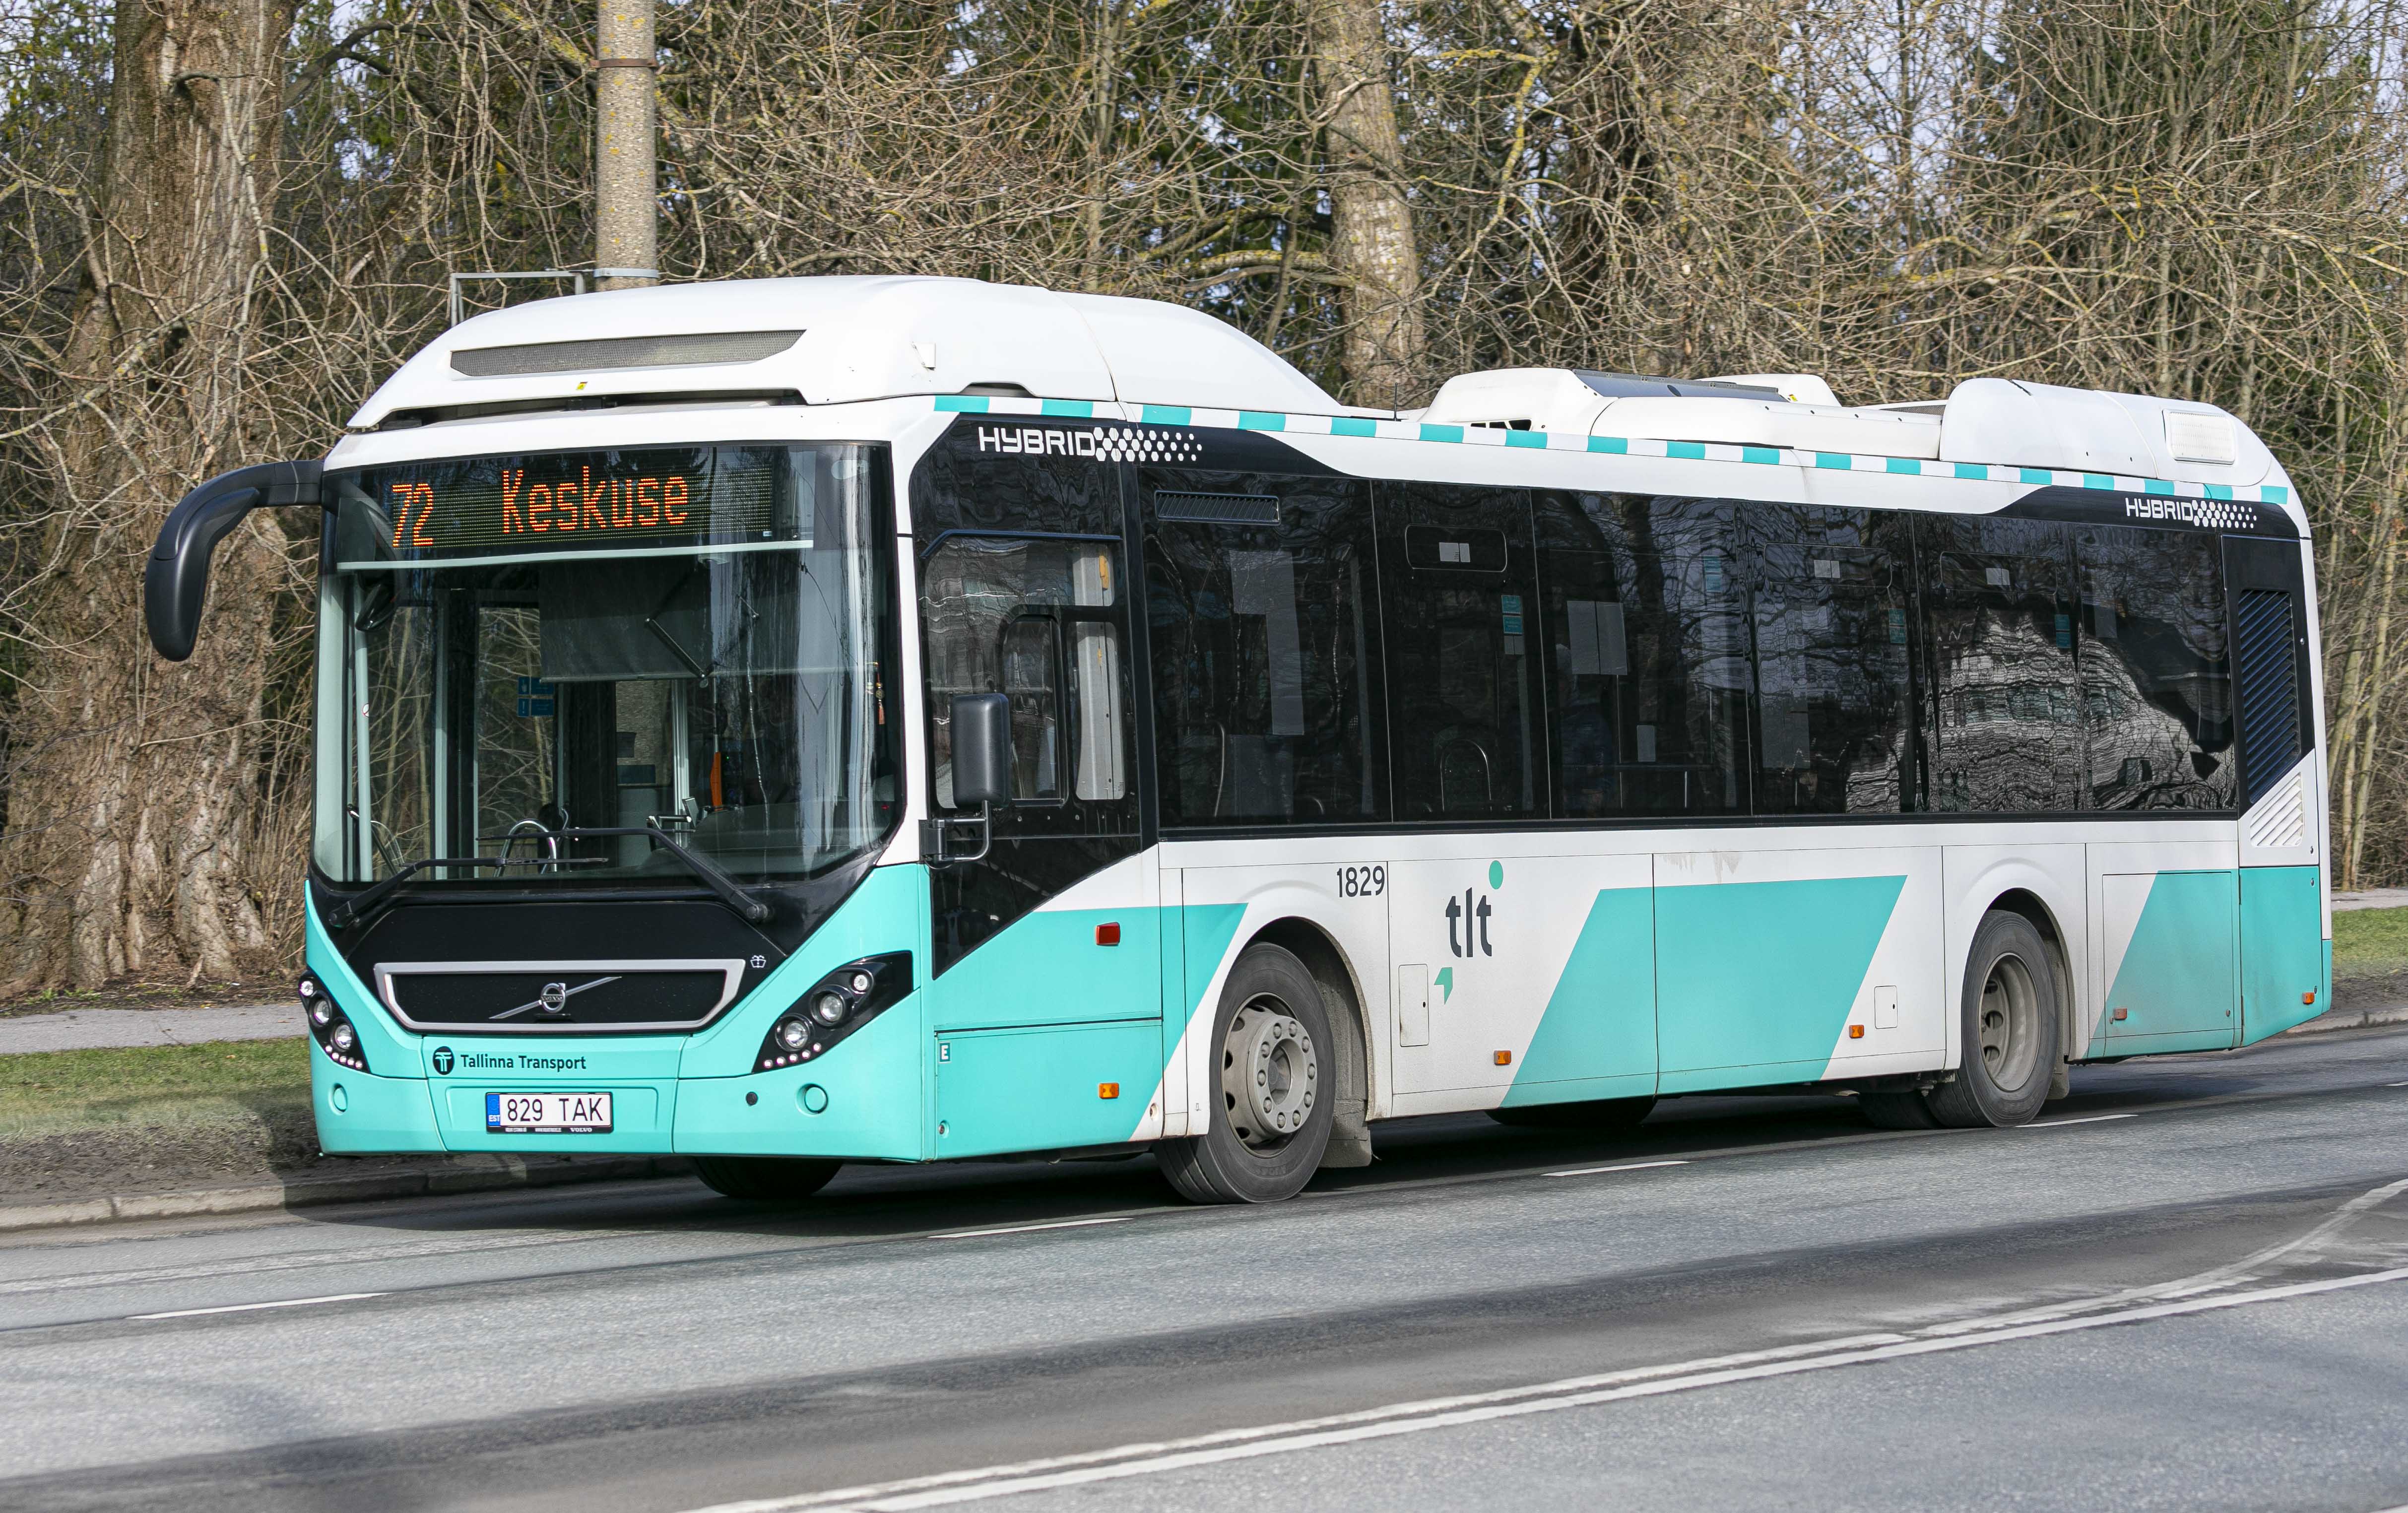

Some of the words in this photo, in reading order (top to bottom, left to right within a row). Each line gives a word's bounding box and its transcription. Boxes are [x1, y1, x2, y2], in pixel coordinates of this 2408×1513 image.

[978, 426, 1096, 457] HYBRID
[391, 482, 434, 547] 72
[503, 465, 689, 533] Keskuse
[2125, 497, 2194, 521] HYBRID
[1336, 865, 1385, 898] 1829
[1445, 887, 1492, 958] tlt
[460, 1053, 514, 1068] Tallinna
[519, 1055, 586, 1072] Transport
[941, 1045, 949, 1060] E
[507, 1098, 543, 1121] 829
[559, 1098, 603, 1121] TAK
